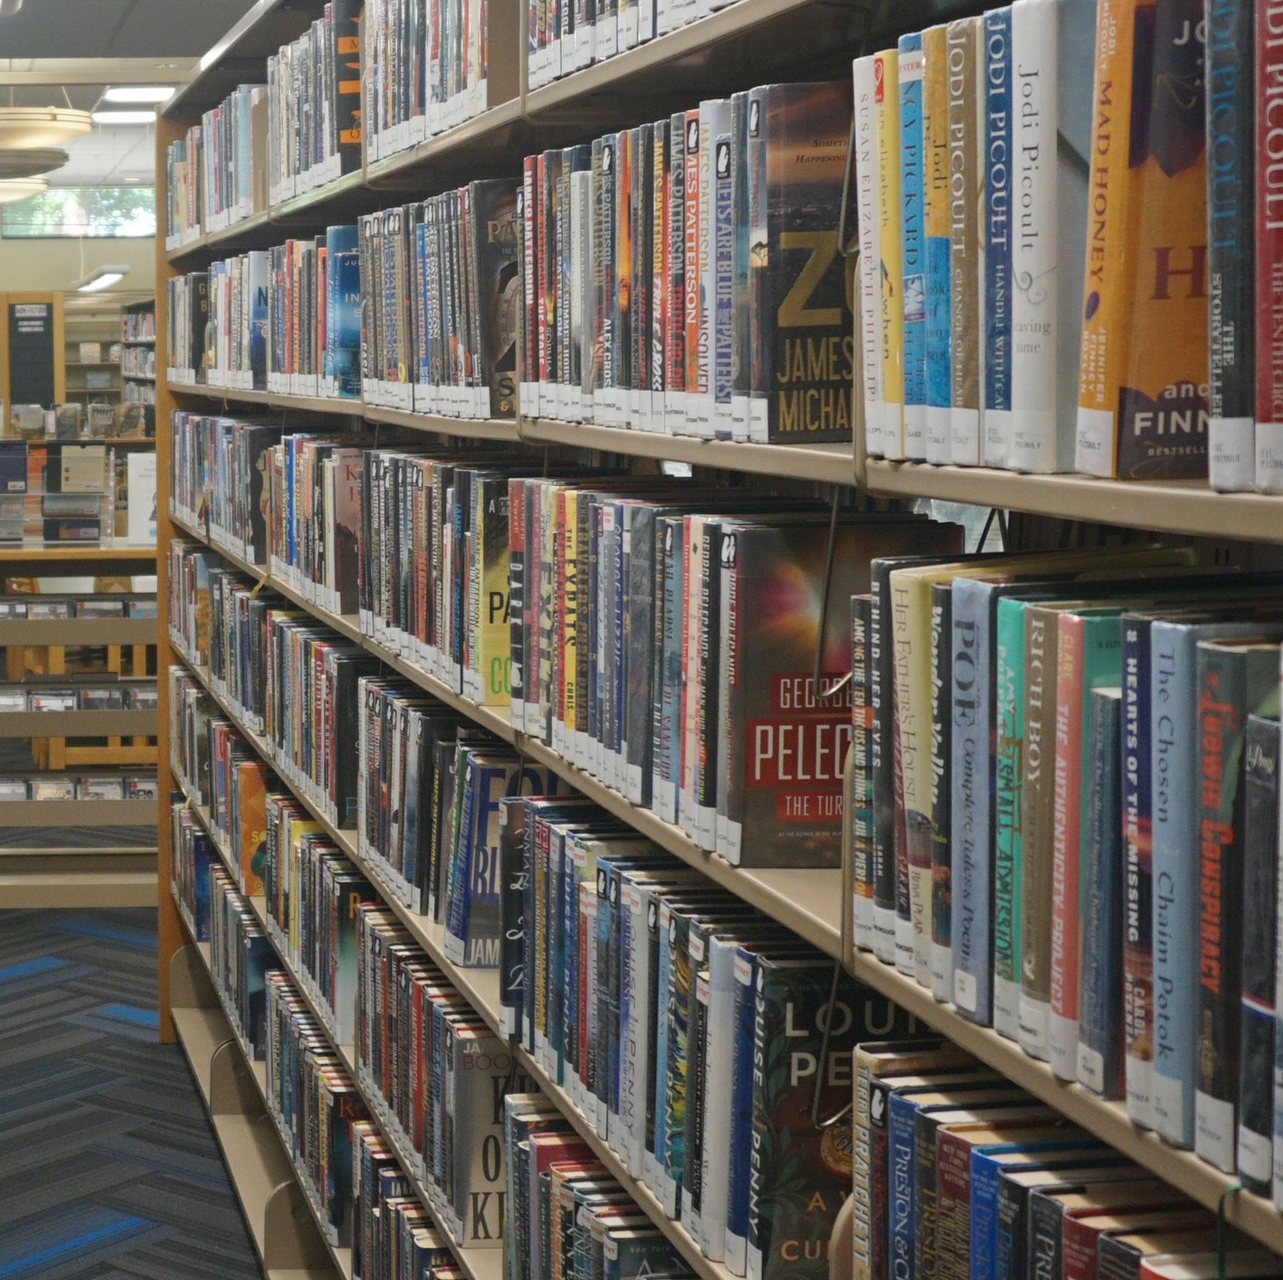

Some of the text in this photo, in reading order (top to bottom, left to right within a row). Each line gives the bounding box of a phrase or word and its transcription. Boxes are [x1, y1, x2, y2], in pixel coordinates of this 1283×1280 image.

[1099, 1, 1109, 71] PICOULT
[1109, 17, 1117, 56] JODI
[671, 129, 684, 183] JAMES
[932, 140, 948, 191] Jodi
[948, 35, 967, 258] JODI PICOULT
[986, 18, 1008, 251] JODI PICOULT
[1017, 64, 1040, 252] Jodi Picoult
[1212, 64, 1239, 257] PICOULT
[1264, 63, 1283, 230] PICOULT
[859, 92, 875, 297] SUSAN ELIZABETH
[904, 144, 919, 266] PICKARD
[1089, 81, 1113, 284] MAD HONEY
[653, 193, 663, 274] PATTERSON
[671, 186, 684, 275] PATTERSON
[685, 199, 699, 324] PATTERSON
[603, 318, 612, 349] ALEX
[995, 264, 1005, 332] HANDLE
[698, 307, 710, 395] UNSOLVED
[777, 337, 853, 384] JAMES
[1086, 333, 1097, 392] FINNEY
[1095, 325, 1107, 404] JENNIFER
[1221, 320, 1235, 367] THE
[509, 561, 523, 626] DARK
[565, 557, 577, 711] EXPATS CHRIS
[701, 587, 711, 659] PELECANOS
[779, 677, 853, 710] GEORGE
[871, 581, 881, 768] BEHIND HER EYES
[894, 587, 914, 725] HER FATHER'S
[953, 620, 977, 729] POE
[1005, 665, 1016, 715] AMY
[1027, 618, 1045, 791] RICH BOY
[784, 795, 810, 817] THE
[1126, 657, 1139, 943] HEARTS OF THE MISSING
[876, 844, 884, 877] SARAH
[1050, 703, 1069, 1014] THE AUTHENTICITY PROJECT
[1157, 647, 1176, 1060] The Chosen Chaim Potok
[1133, 986, 1146, 1037] CAROL
[855, 1065, 868, 1122] TERRY
[746, 1130, 761, 1235] PENNY
[853, 1124, 869, 1267] PRATCHETT
[894, 1144, 912, 1234] PRESTON
[894, 1235, 909, 1256] &
